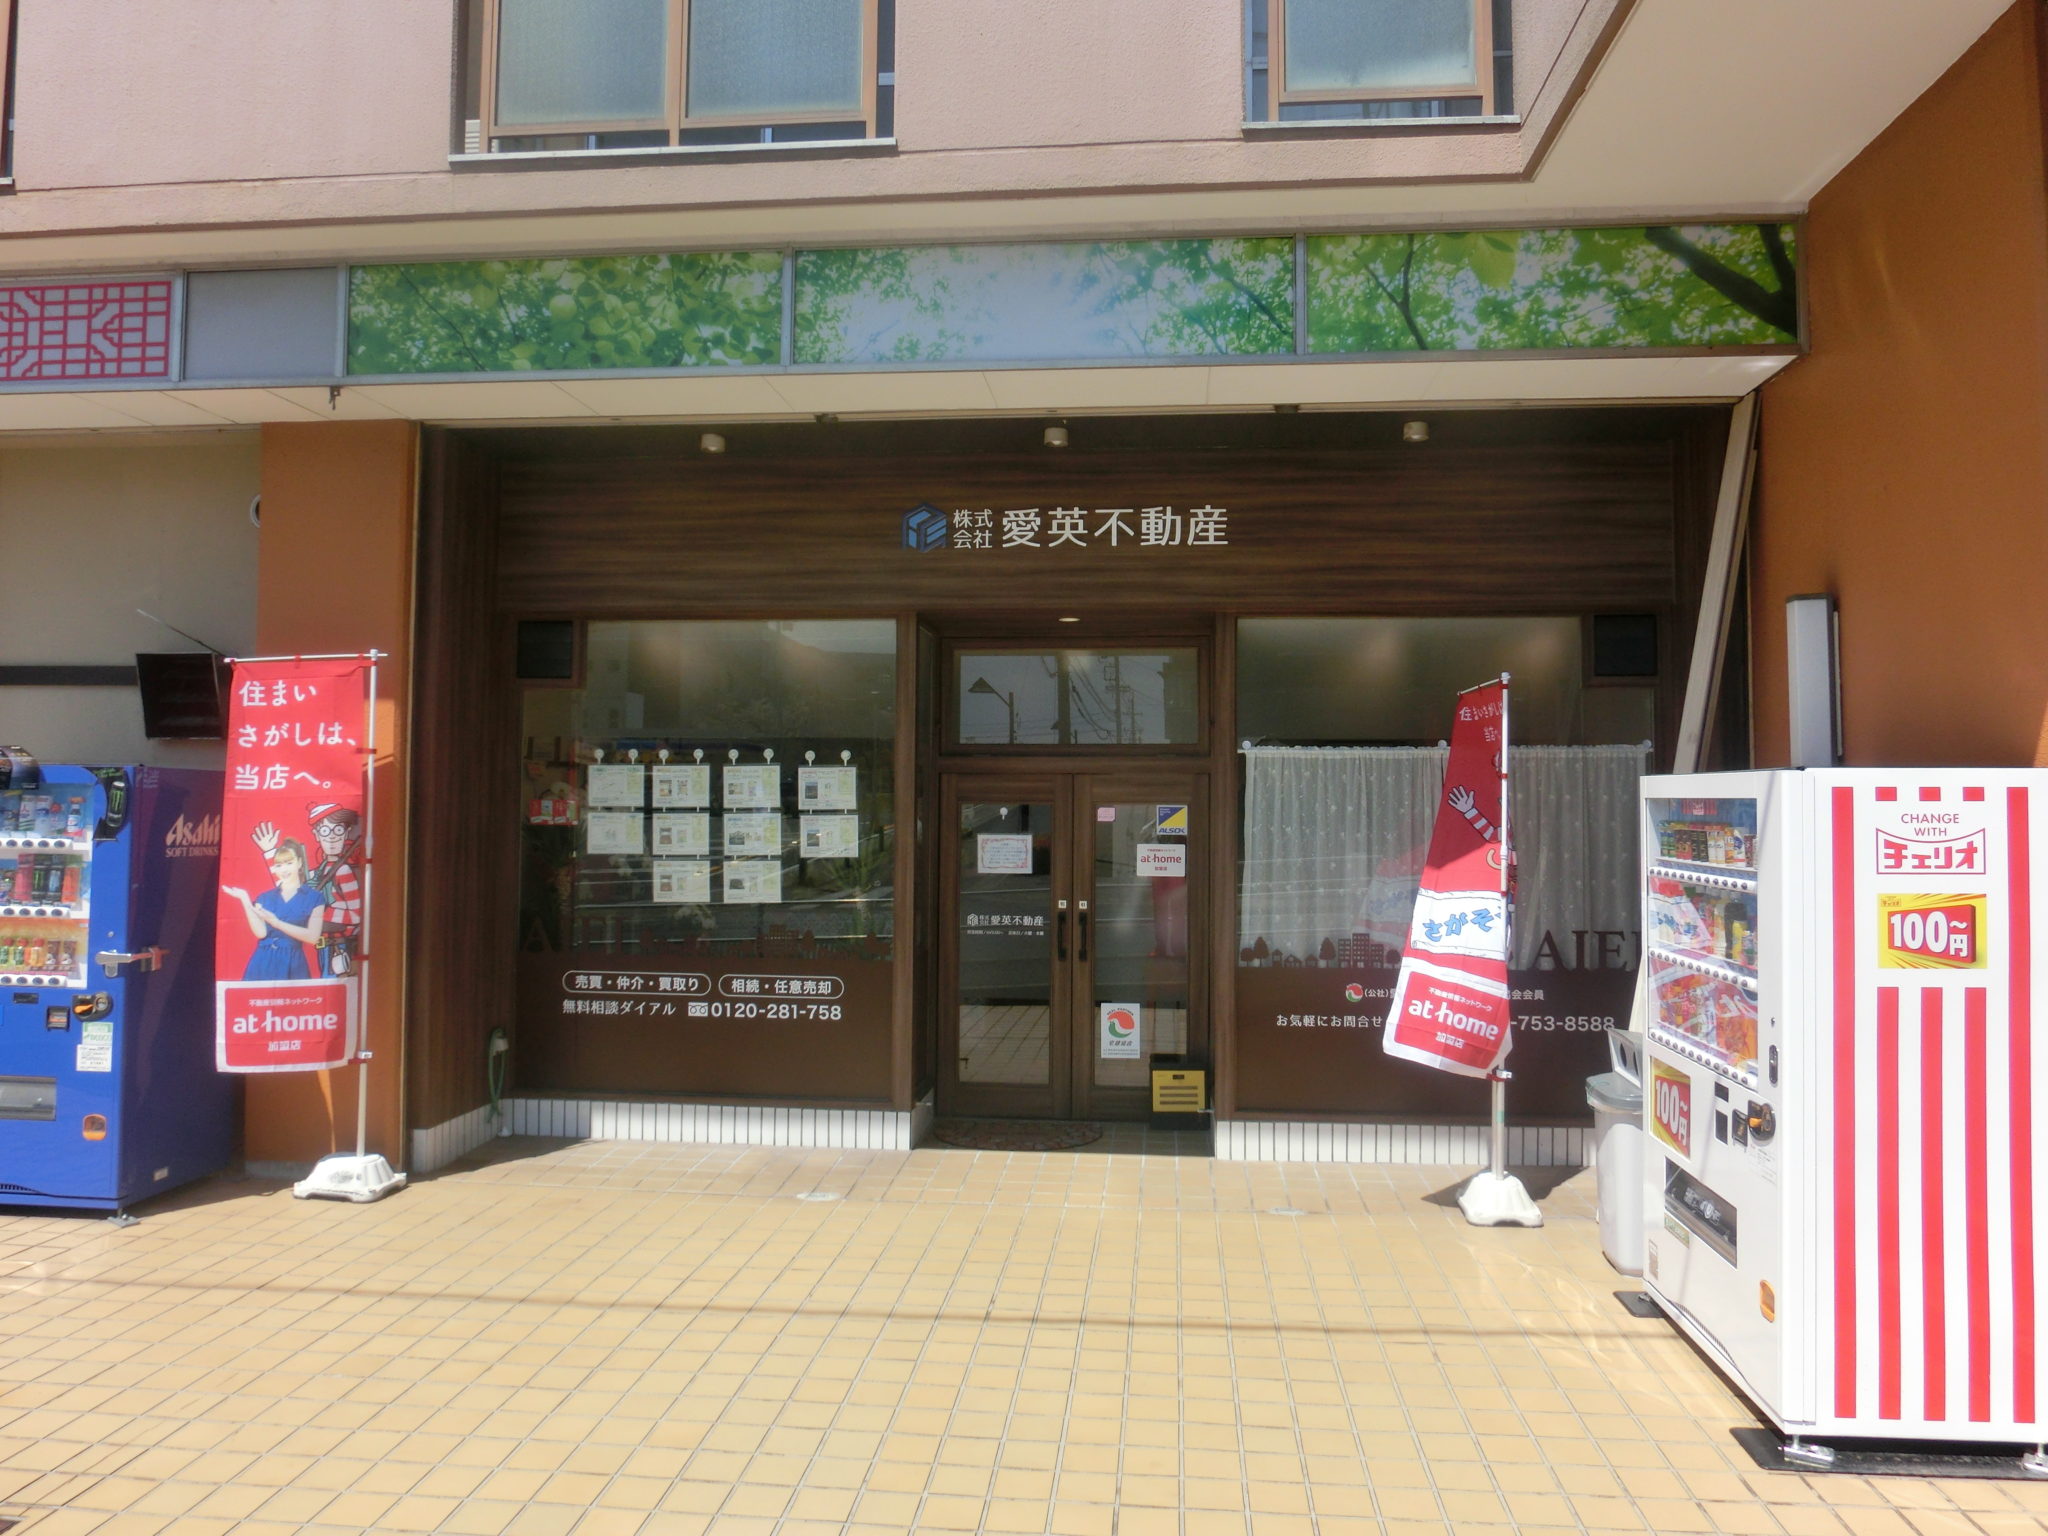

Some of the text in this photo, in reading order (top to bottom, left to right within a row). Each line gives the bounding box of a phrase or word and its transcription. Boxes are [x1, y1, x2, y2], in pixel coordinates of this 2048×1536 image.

[953, 508, 993, 529] 株式
[1001, 504, 1230, 548] 愛英不動産
[952, 529, 993, 550] 会社
[238, 680, 317, 707] 住まい
[238, 722, 356, 748] さがしは、
[234, 763, 332, 790] 当店へ。
[1900, 813, 1960, 824] CHANGE
[165, 813, 221, 846] Asahi
[1914, 827, 1947, 837] WITH
[165, 847, 188, 858] SOFT
[1152, 853, 1182, 864] home
[1883, 838, 1978, 869] チェリオ
[575, 975, 699, 991] 売買・仲介・買取り
[731, 978, 832, 995] 相続・任意売却
[562, 999, 677, 1016] 無料相談ダイアル
[711, 1002, 842, 1020] 0120-281-758
[232, 1010, 338, 1034] at home
[1276, 1014, 1382, 1028] お気軽にお問合せ
[1408, 999, 1499, 1041] at home
